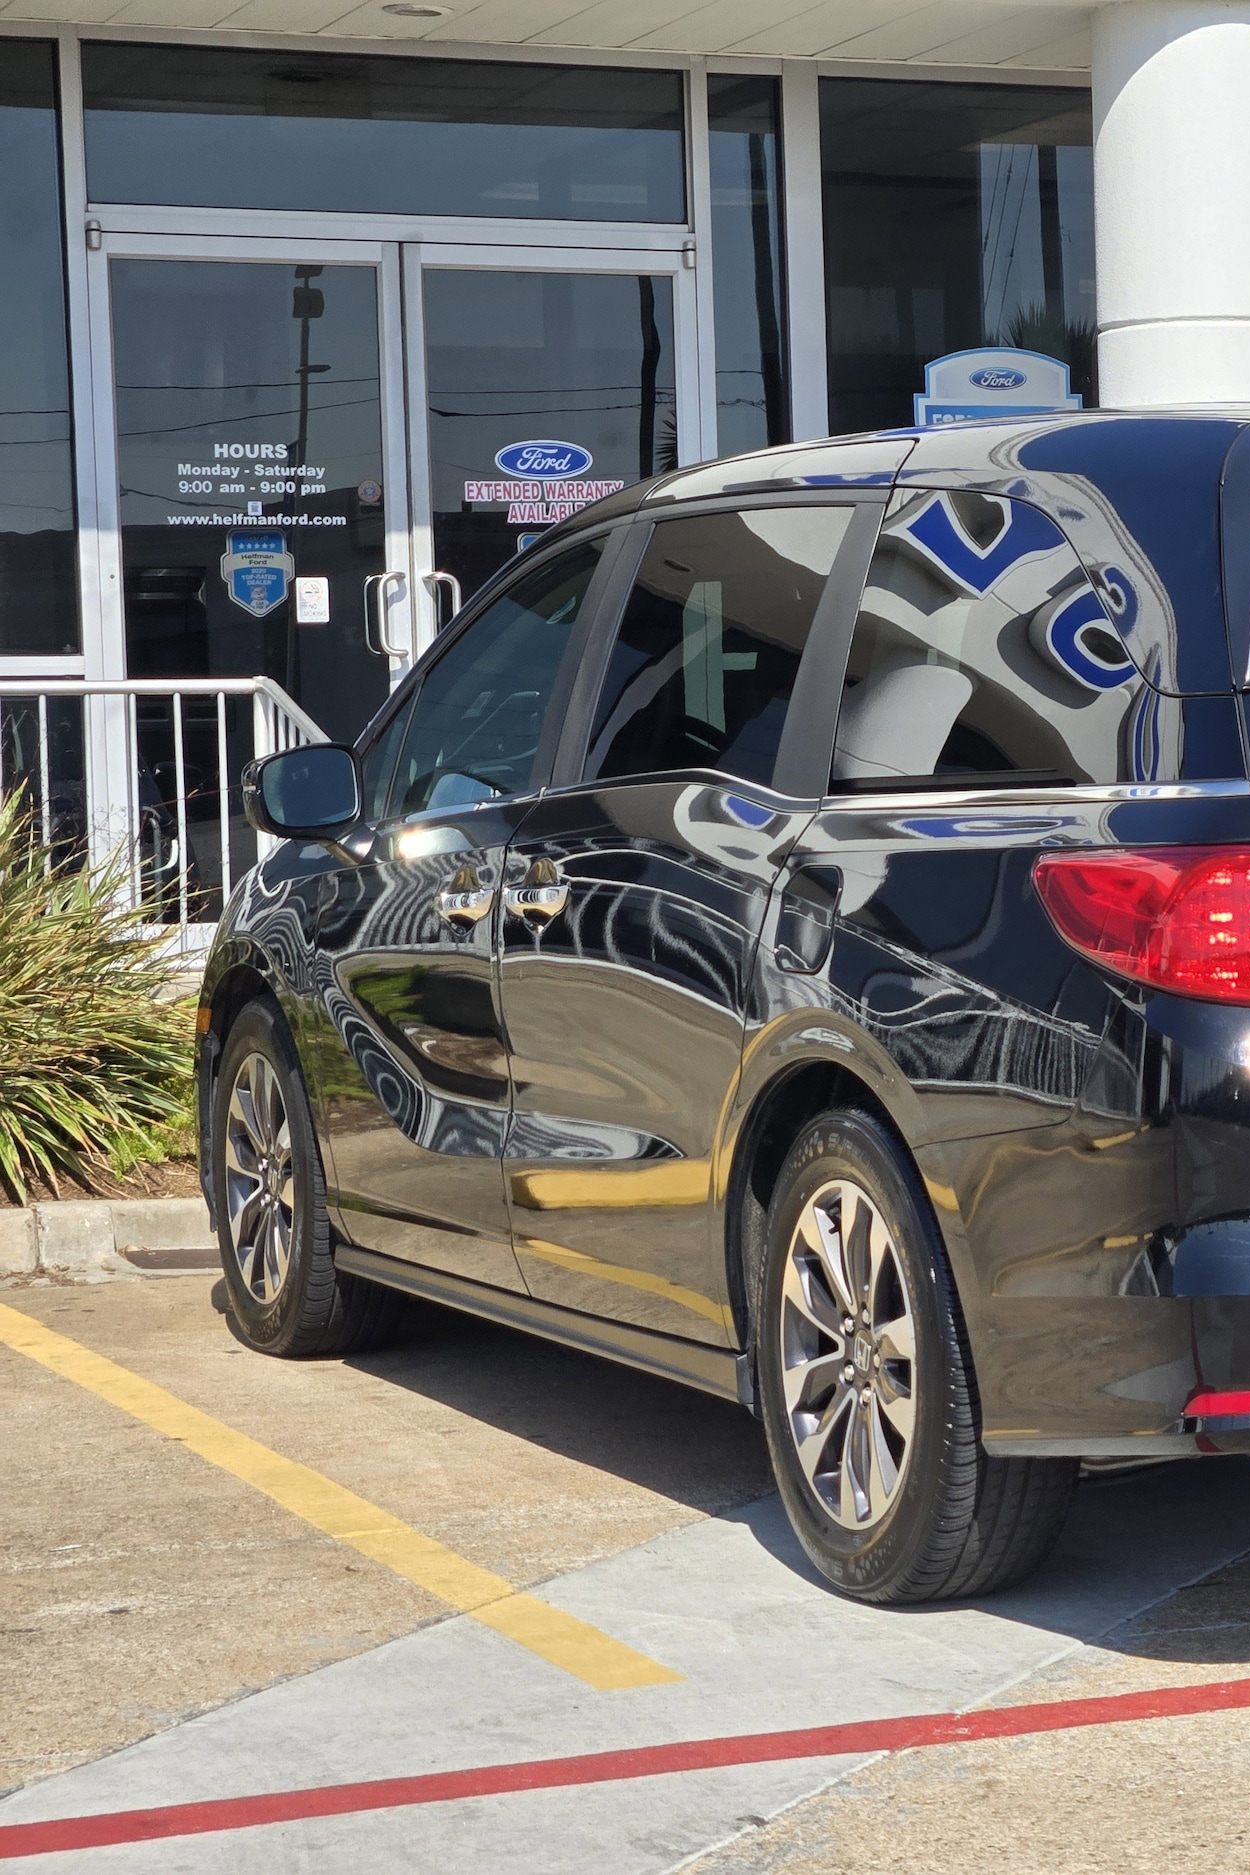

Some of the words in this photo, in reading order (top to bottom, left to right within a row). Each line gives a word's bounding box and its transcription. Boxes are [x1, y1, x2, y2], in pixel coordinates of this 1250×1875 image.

[980, 370, 1015, 387] Ford
[213, 443, 288, 458] HOURS
[516, 446, 572, 471] Ford
[177, 463, 240, 478] Monday
[254, 464, 326, 479] Saturday
[178, 480, 213, 493] 9:00
[219, 483, 245, 493] am
[260, 481, 296, 493] 9:00
[301, 483, 326, 496] pm
[464, 481, 542, 501] EXTENDED
[167, 513, 347, 526] www.helfmanford.com
